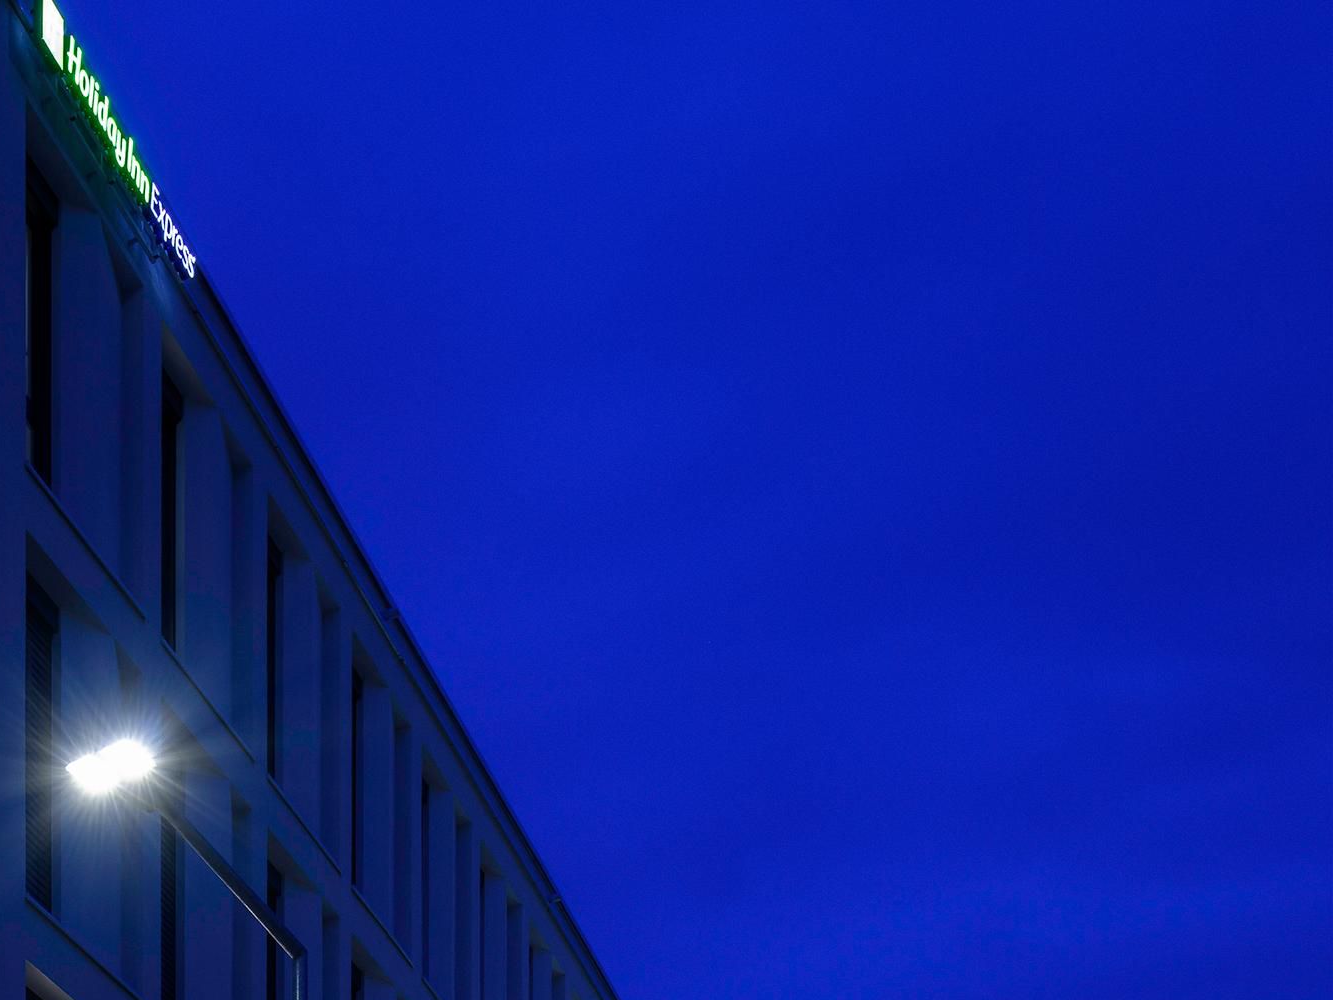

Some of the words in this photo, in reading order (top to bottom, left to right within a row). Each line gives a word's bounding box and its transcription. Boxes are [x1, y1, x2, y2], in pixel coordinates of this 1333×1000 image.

[67, 35, 126, 167] Holiday
[126, 137, 150, 203] Inn
[151, 182, 196, 278] Express
